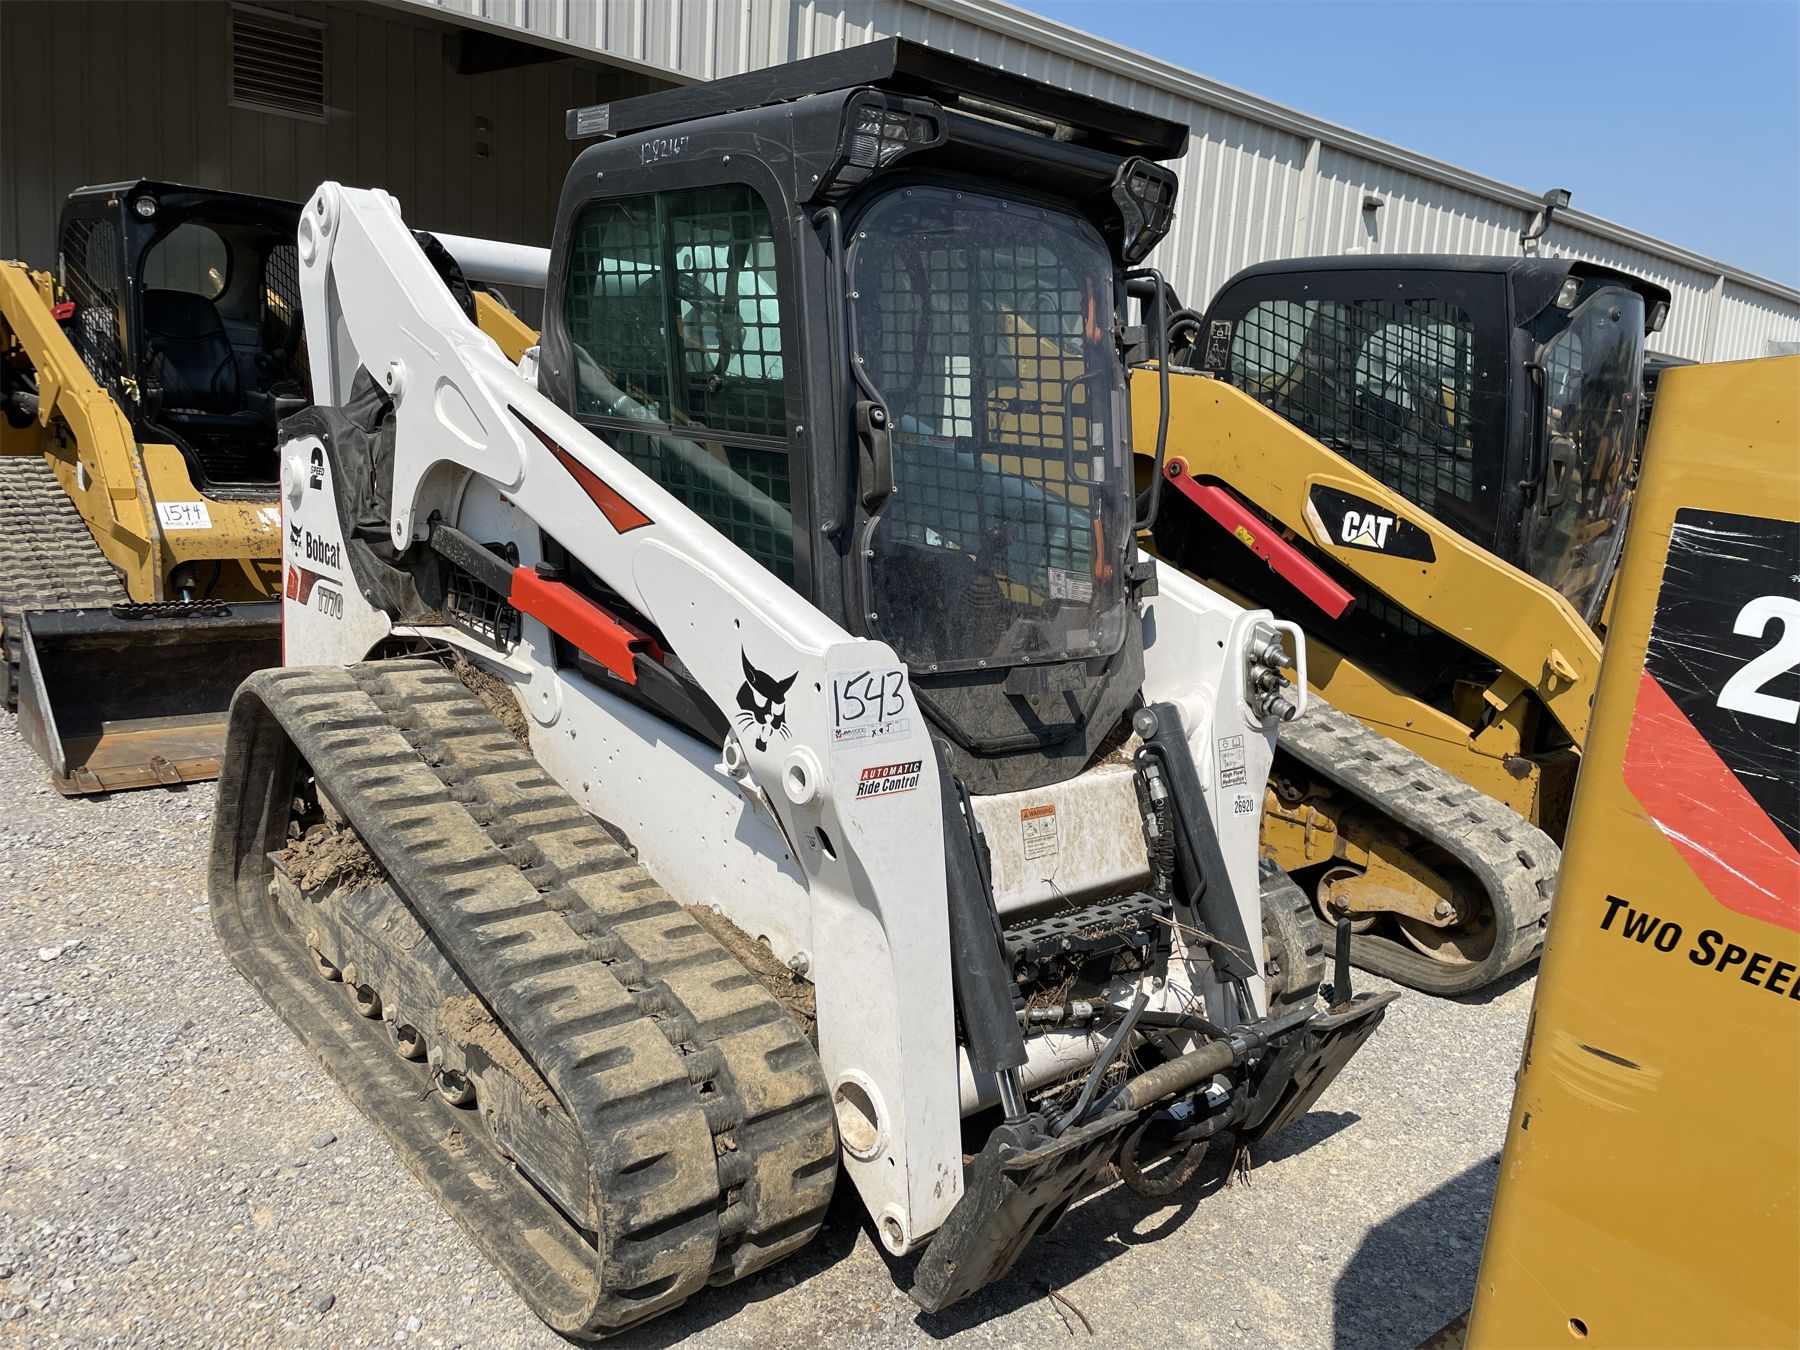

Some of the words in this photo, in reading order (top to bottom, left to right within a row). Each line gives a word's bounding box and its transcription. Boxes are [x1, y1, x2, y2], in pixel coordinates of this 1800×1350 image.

[310, 465, 325, 477] SPEED
[163, 504, 201, 521] 1544
[1342, 511, 1393, 549] CAT
[306, 531, 341, 570] Bobcat
[318, 585, 343, 620] T770
[834, 671, 904, 726] 1543
[862, 763, 920, 780] AUTOMATIC
[857, 780, 880, 796] Ride
[882, 774, 919, 791] Control
[1234, 799, 1254, 814] 26920
